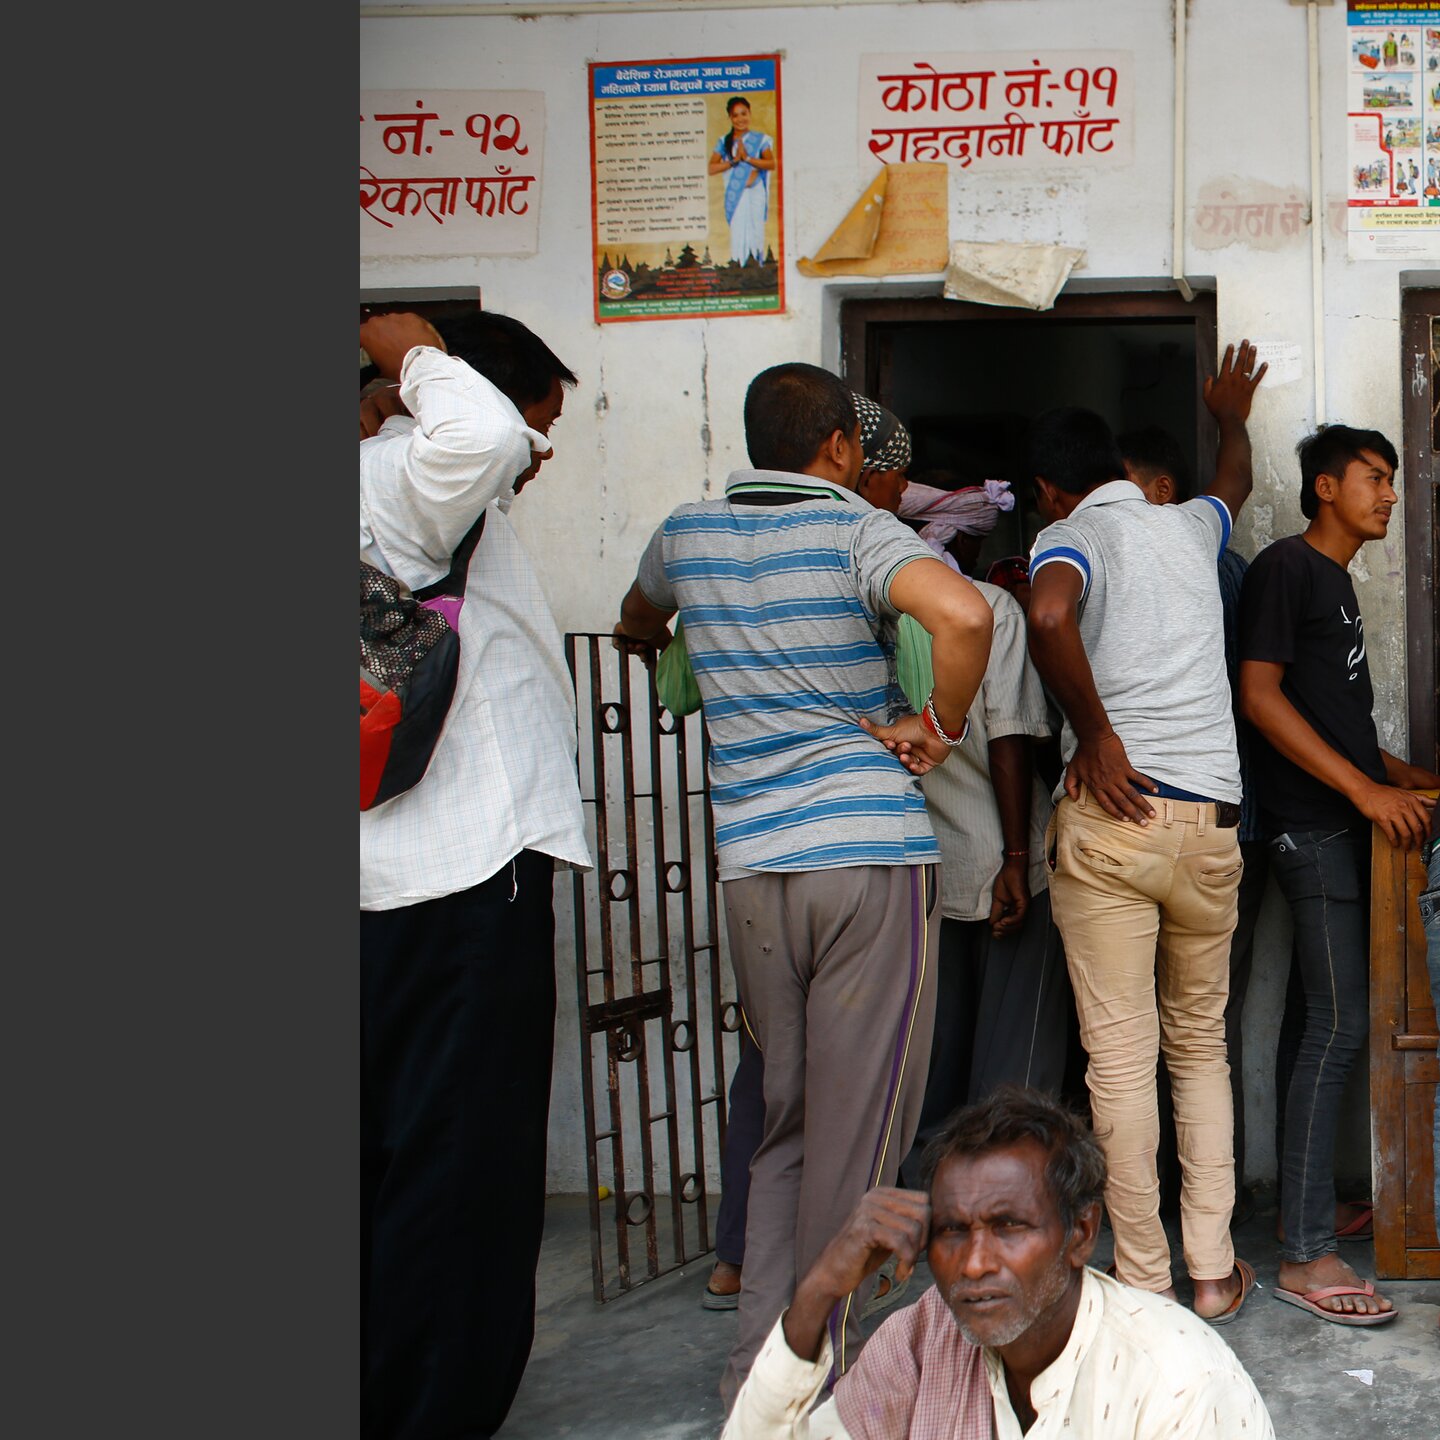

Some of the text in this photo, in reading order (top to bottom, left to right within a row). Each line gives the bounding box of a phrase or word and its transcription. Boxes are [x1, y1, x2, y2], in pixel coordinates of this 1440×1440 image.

[601, 82, 641, 95] महिलाले
[877, 62, 996, 113] कोठा
[868, 110, 1120, 168] राहदानी फाँट
[465, 165, 536, 217] फाँट
